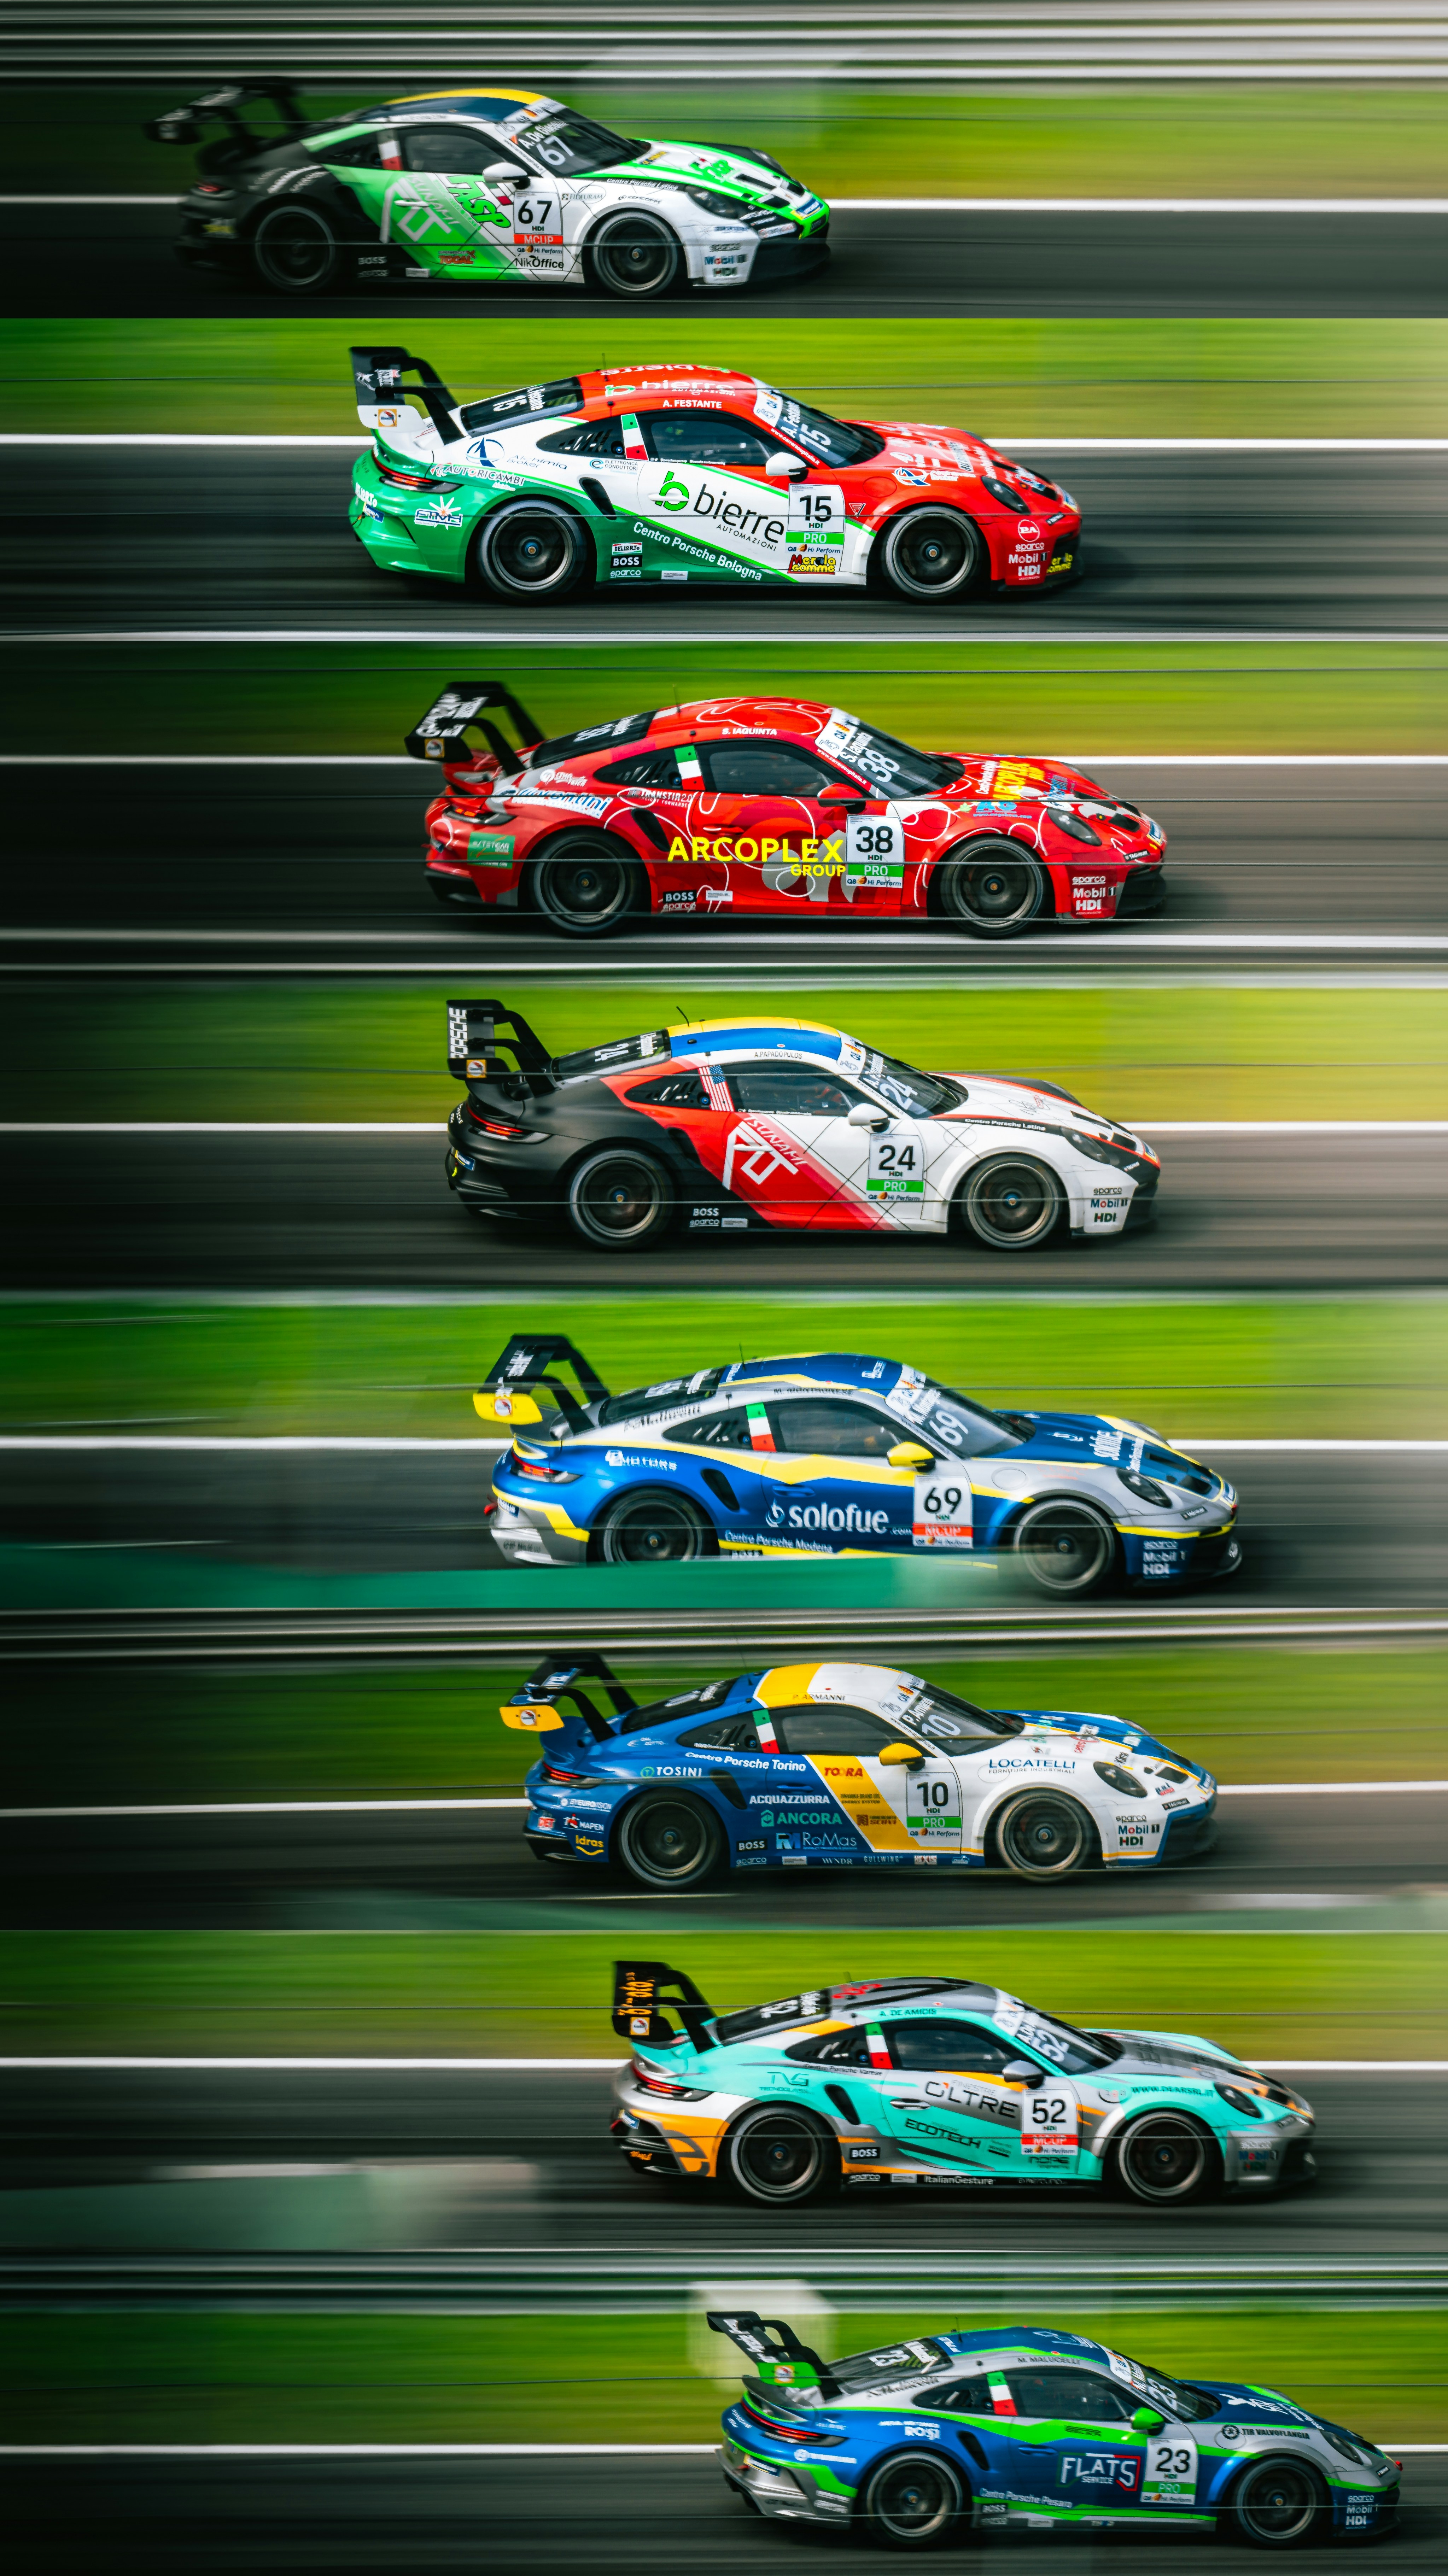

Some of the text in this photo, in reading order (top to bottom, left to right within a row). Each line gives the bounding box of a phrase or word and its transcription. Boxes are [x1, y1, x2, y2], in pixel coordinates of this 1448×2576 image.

[536, 135, 575, 165] 67
[518, 200, 552, 224] 67
[524, 235, 554, 244] MCUP
[516, 254, 564, 268] NikOffice
[705, 255, 734, 265] Mobil
[642, 380, 735, 394] bierre
[492, 395, 528, 412] 15
[675, 400, 722, 408] FESTANTE
[799, 424, 831, 452] 15
[771, 427, 820, 465] www.carreracupitalia.it
[507, 459, 541, 468] Broker
[445, 466, 525, 486] AUTORICAMBI
[694, 484, 784, 543] bierre
[800, 496, 831, 522] 15
[716, 525, 777, 551] AUTOMAZIONI
[804, 533, 827, 543] PRO
[634, 522, 762, 580] Centro Porsche Bologna
[1015, 543, 1044, 551] sparco
[613, 557, 639, 566] BOSS
[1009, 554, 1038, 563] Mobil
[1018, 564, 1040, 576] HDI
[817, 748, 867, 784] www.carreracupitalia.it
[852, 750, 900, 782] 38
[856, 826, 893, 853] 38
[667, 837, 844, 862] ARCOPLEX
[790, 865, 846, 876] GROUP
[864, 865, 888, 876] PRO
[1072, 877, 1106, 885] sparco
[665, 892, 694, 902] BOSS
[1073, 888, 1105, 897] Mobil
[1076, 900, 1102, 911] HDI
[595, 1043, 629, 1062] 24
[856, 1079, 904, 1115] www.carreracupitalia.it
[880, 1075, 918, 1110] 24
[743, 1115, 808, 1166] TSUNAMI
[878, 1145, 916, 1171] 24
[884, 1181, 906, 1192] PRO
[1094, 1187, 1122, 1195] sparco
[1091, 1199, 1119, 1208] Mobil
[1094, 1213, 1116, 1222] HDI
[929, 1410, 969, 1446] 69
[923, 1487, 962, 1514] 69
[788, 1501, 889, 1534] solofue
[725, 1530, 833, 1553] Centro Porsche Modena
[1143, 1551, 1176, 1561] Mobil
[1143, 1564, 1169, 1574] HDI
[921, 1715, 961, 1742] 10
[685, 1752, 806, 1772] Centro Porsche Torino
[989, 1759, 1075, 1768] LOCATELLI
[656, 1767, 702, 1777] TOSINI
[749, 1795, 830, 1804] ACQUAZZURRA
[917, 1782, 949, 1807] 10
[777, 1813, 842, 1824] ANCORA
[923, 1818, 945, 1827] PRO
[1118, 1825, 1148, 1833] Mobil
[738, 1841, 765, 1850] BOSS
[802, 1832, 857, 1846] RoMas
[1119, 1836, 1143, 1846] HDI
[736, 1857, 766, 1865] sparco
[1033, 2028, 1070, 2061] 52
[952, 2079, 996, 2096] FINESTRE
[1032, 2098, 1067, 2124] 52
[905, 2117, 981, 2149] ECOTECH
[851, 2149, 877, 2158] BOSS
[924, 2176, 993, 2185] ItalianGesture
[1147, 2377, 1178, 2411] 23
[1155, 2447, 1191, 2473] 23
[1061, 2457, 1137, 2487] FLATS
[1158, 2484, 1181, 2493] PRO
[980, 2488, 1073, 2508] Centro Porsche Pesaro
[1347, 2506, 1372, 2514] Mobil
[1346, 2516, 1366, 2525] HDI
